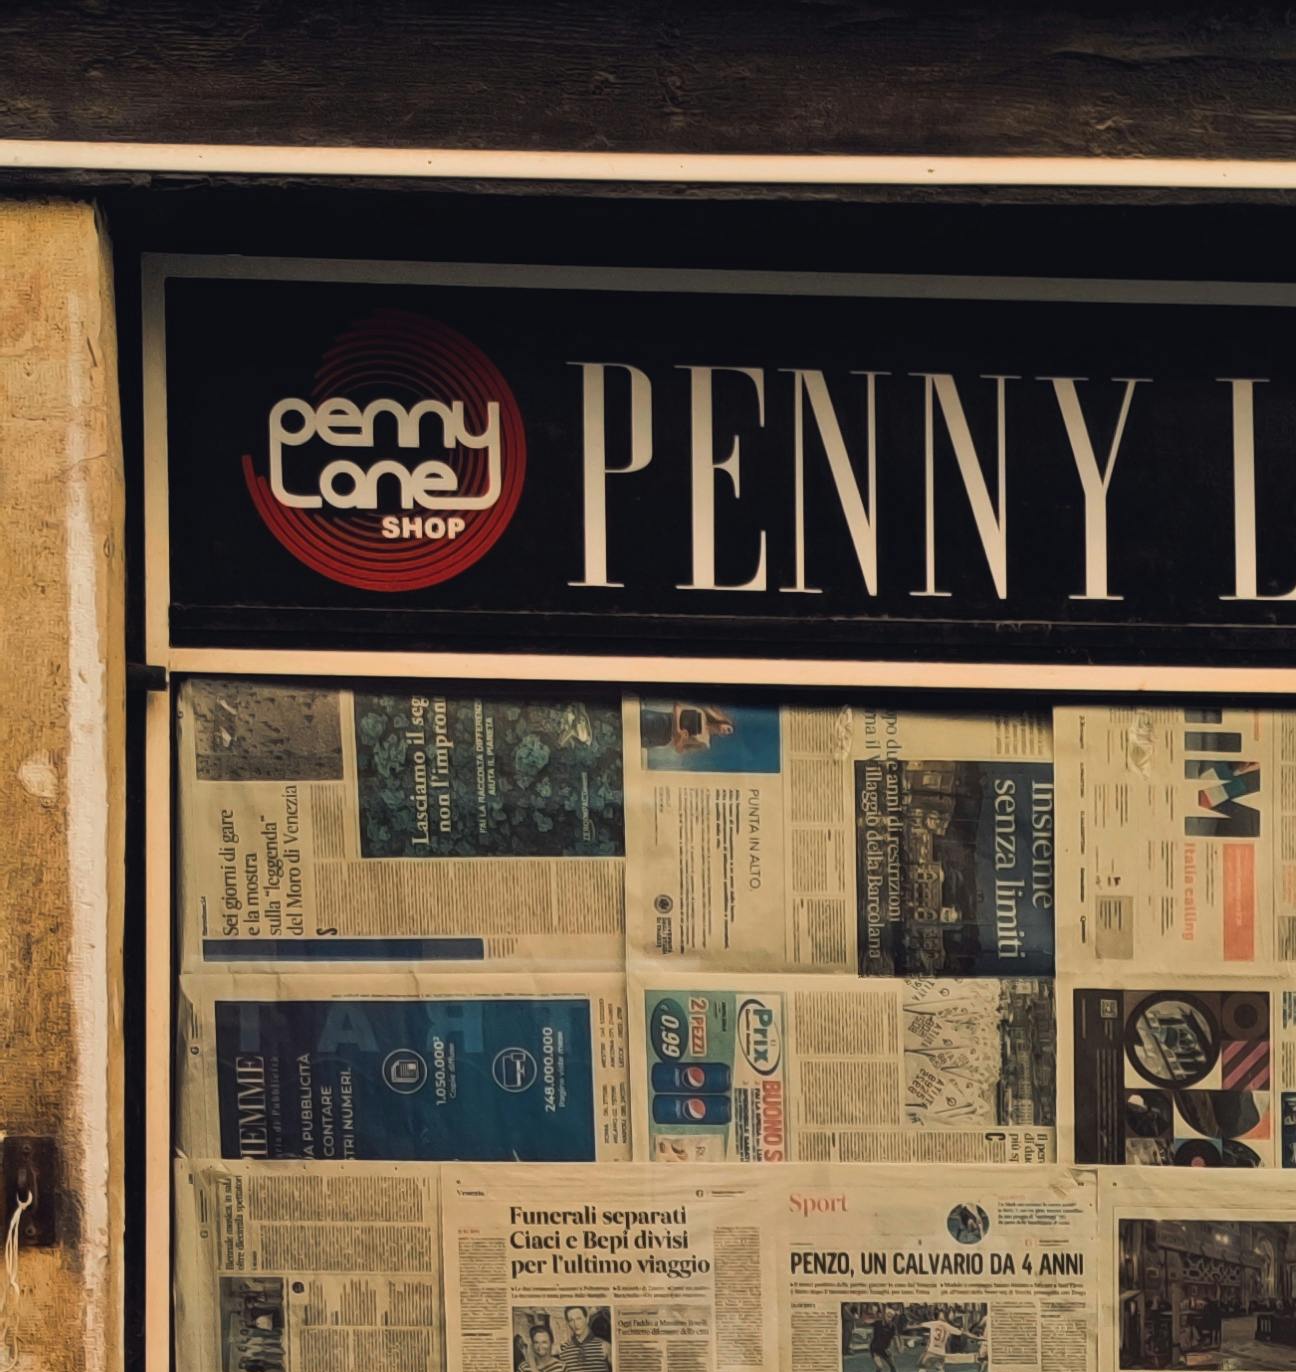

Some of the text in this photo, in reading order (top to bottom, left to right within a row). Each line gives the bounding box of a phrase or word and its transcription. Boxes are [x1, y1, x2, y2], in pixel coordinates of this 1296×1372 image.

[269, 398, 500, 451] penny
[566, 361, 1154, 602] PENNY
[382, 516, 465, 539] SHOP
[410, 732, 430, 844] Lasciamo il
[439, 794, 450, 832] non
[748, 789, 760, 834] PUNTA
[220, 810, 244, 936] Sei giorni di gare
[284, 786, 304, 935] del Moro di Venezia
[750, 837, 760, 851] IN
[995, 780, 1024, 956] senza limiti
[1032, 781, 1052, 908] Insieme
[244, 853, 260, 936] e la mostra
[259, 815, 283, 935] sulla "leggenda"
[691, 999, 706, 1011] 2
[660, 1014, 681, 1058] 0,99
[752, 1007, 774, 1065] Prix
[298, 1054, 312, 1140] PUBBLICITÀ
[321, 1086, 334, 1156] CONTARE
[341, 1068, 353, 1130] NUMERI.
[762, 1080, 782, 1146] BUONO
[510, 1206, 686, 1228] Funerali separati
[790, 1193, 848, 1217] Sport
[510, 1229, 688, 1253] Ciaci e Bepi divisi
[512, 1254, 710, 1278] per l'ultimo viaggio
[791, 1252, 1083, 1276] PENZO, UN CALVARIO DA 4 ANNI
